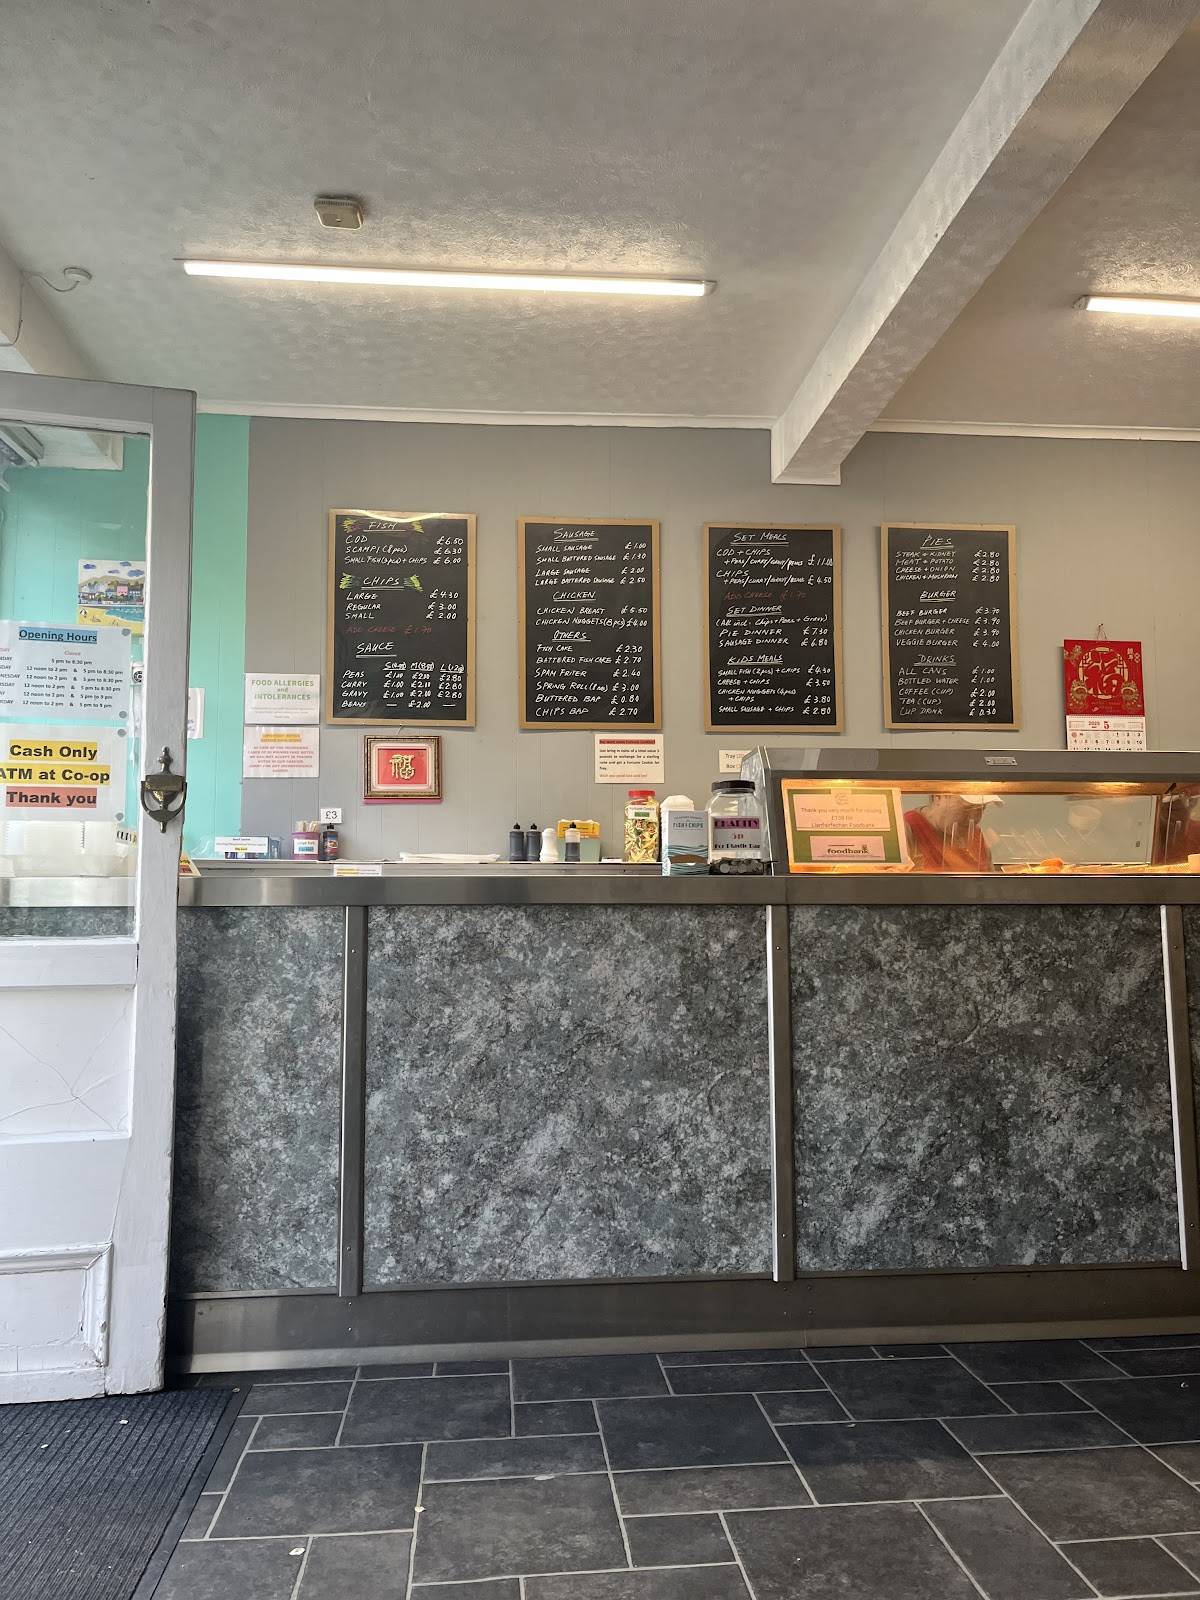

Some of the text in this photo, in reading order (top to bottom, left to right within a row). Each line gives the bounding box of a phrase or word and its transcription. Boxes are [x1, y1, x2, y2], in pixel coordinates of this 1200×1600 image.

[368, 521, 397, 529] FISH
[554, 528, 595, 539] SAUSAGE
[733, 533, 787, 542] SET MEALS
[346, 535, 368, 544] COD
[922, 534, 952, 547] PIES
[536, 557, 559, 565] SMALL
[535, 568, 560, 577] LARGE
[363, 576, 399, 586] CHIPS
[552, 591, 596, 600] CHICKEN
[920, 590, 956, 598] BURGER
[728, 606, 746, 615] SET
[19, 630, 97, 642] Opening Hours
[554, 630, 587, 639] OTHERS
[356, 642, 394, 654] SAUCE
[719, 639, 752, 648] SAUSAGE
[728, 656, 754, 664] KIDS
[918, 654, 955, 663] DRINKS
[342, 670, 365, 678] PEAS
[535, 668, 556, 677] SPAM
[536, 707, 565, 716] CHIPS
[900, 707, 916, 715] CUP
[1104, 720, 1110, 729] 5
[10, 745, 97, 760] Cash Only
[0, 768, 110, 783] ATM at Co-op
[7, 792, 96, 806] Thank you
[326, 810, 338, 819] £3
